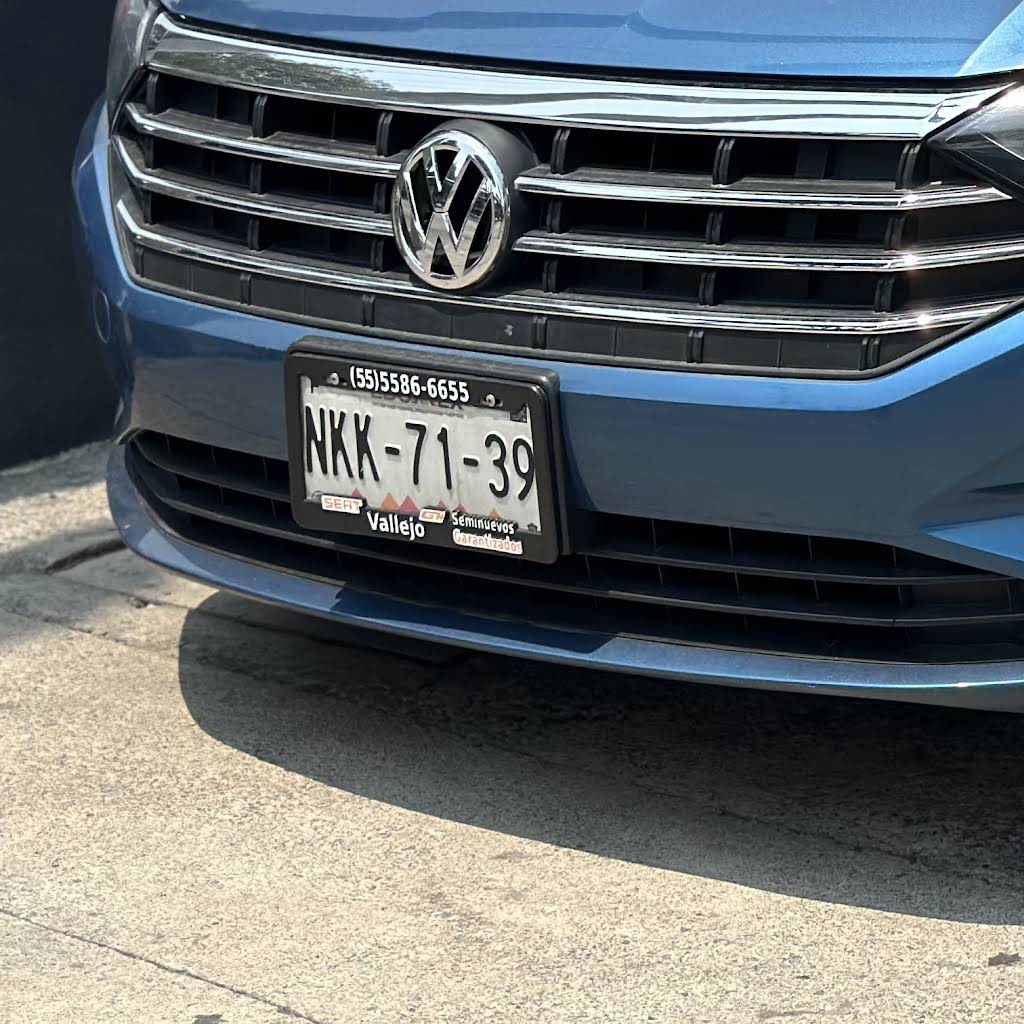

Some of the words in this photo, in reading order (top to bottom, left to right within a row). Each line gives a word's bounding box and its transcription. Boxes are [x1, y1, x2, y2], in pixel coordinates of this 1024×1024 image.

[397, 134, 504, 286] VW
[350, 365, 470, 403] (55)5586-6655
[304, 403, 535, 502] NKK-71-39
[321, 496, 363, 513] SEAT
[367, 511, 425, 540] Vallejo
[452, 510, 515, 535] Seminuevos
[453, 529, 522, 554] Garantizados
